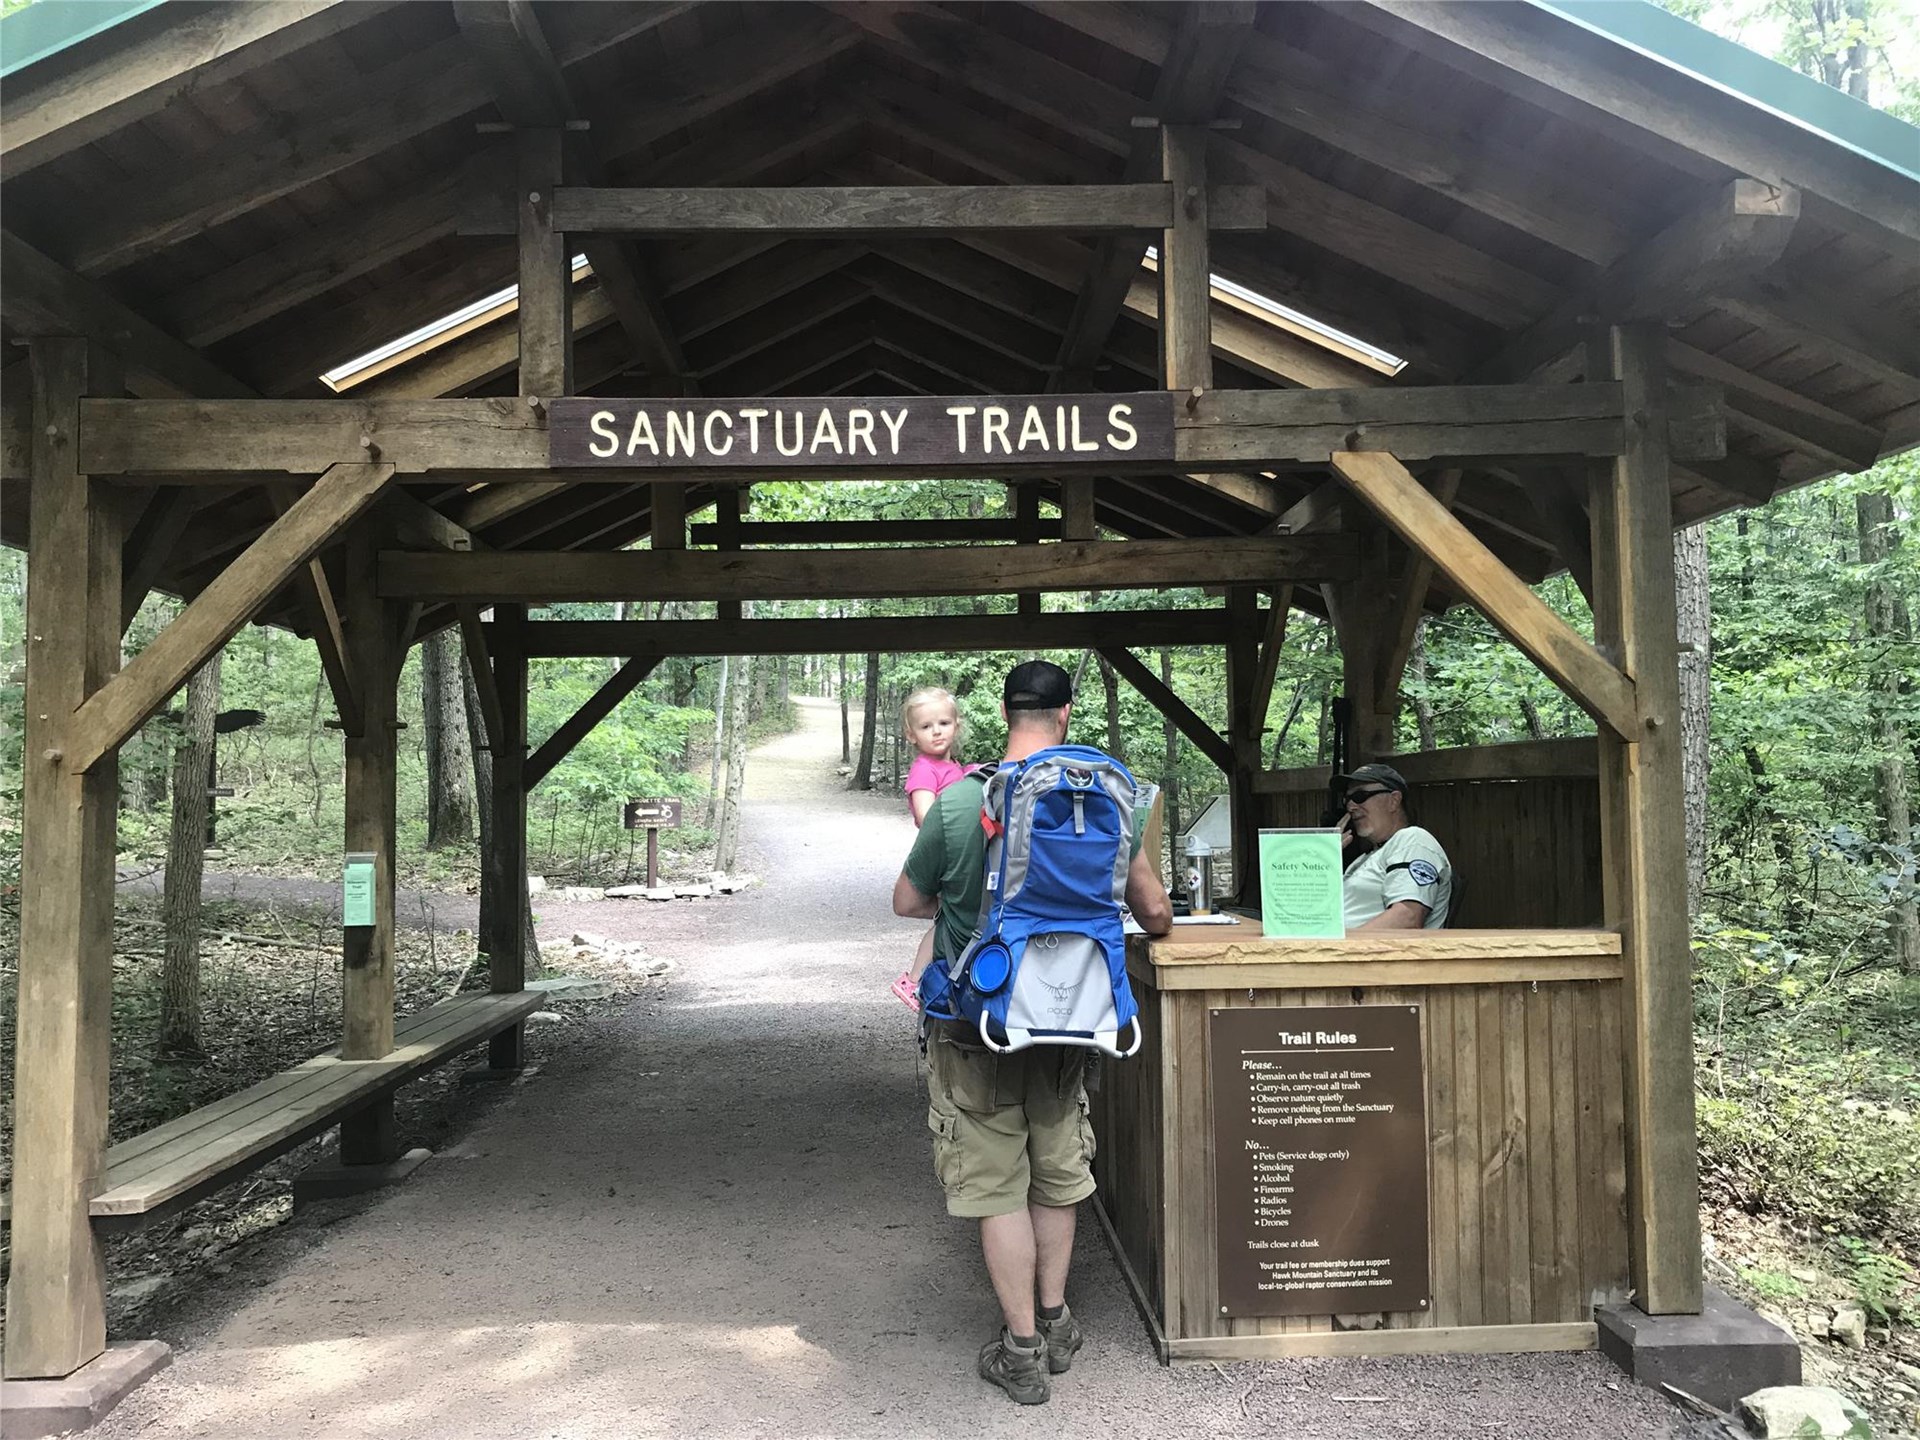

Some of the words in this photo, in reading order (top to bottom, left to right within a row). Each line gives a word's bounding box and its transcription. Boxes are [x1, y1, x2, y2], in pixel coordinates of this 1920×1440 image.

[588, 407, 909, 458] SANCTUARY
[945, 403, 1138, 455] TRAILS
[1271, 862, 1299, 872] Safety
[1302, 862, 1331, 871] Notice
[1046, 1007, 1073, 1016] POCO
[1278, 1032, 1312, 1044] Trail
[1316, 1031, 1357, 1044] Rules
[1299, 1071, 1312, 1079] the
[1313, 1071, 1329, 1079] trail
[1256, 1083, 1291, 1093] Carry-in,
[1293, 1083, 1329, 1091] carry-out
[1330, 1082, 1340, 1090] all
[1341, 1081, 1361, 1089] trash
[1256, 1094, 1289, 1102] Observe
[1317, 1093, 1344, 1103] quietly
[1290, 1104, 1321, 1115] nothing
[1322, 1104, 1341, 1112] from
[1356, 1104, 1394, 1113] Sanctuary
[1258, 1117, 1278, 1126] Keep
[1279, 1116, 1293, 1124] cell
[1294, 1116, 1322, 1126] phones
[1276, 1152, 1307, 1160] (Service
[1308, 1151, 1327, 1161] dogs
[1329, 1150, 1350, 1160] only)
[1259, 1163, 1294, 1173] Smoking
[1259, 1174, 1290, 1182] Alcohol
[1260, 1196, 1287, 1204] Radios
[1260, 1207, 1292, 1217] Bicycles
[1247, 1241, 1269, 1249] Trails
[1270, 1240, 1289, 1248] close
[1299, 1239, 1320, 1247] dusk
[1308, 1260, 1348, 1268] membership
[1366, 1259, 1390, 1267] support
[1324, 1270, 1356, 1278] Sanctuary
[1258, 1281, 1304, 1290] local-to-global
[1326, 1280, 1367, 1288] conservation
